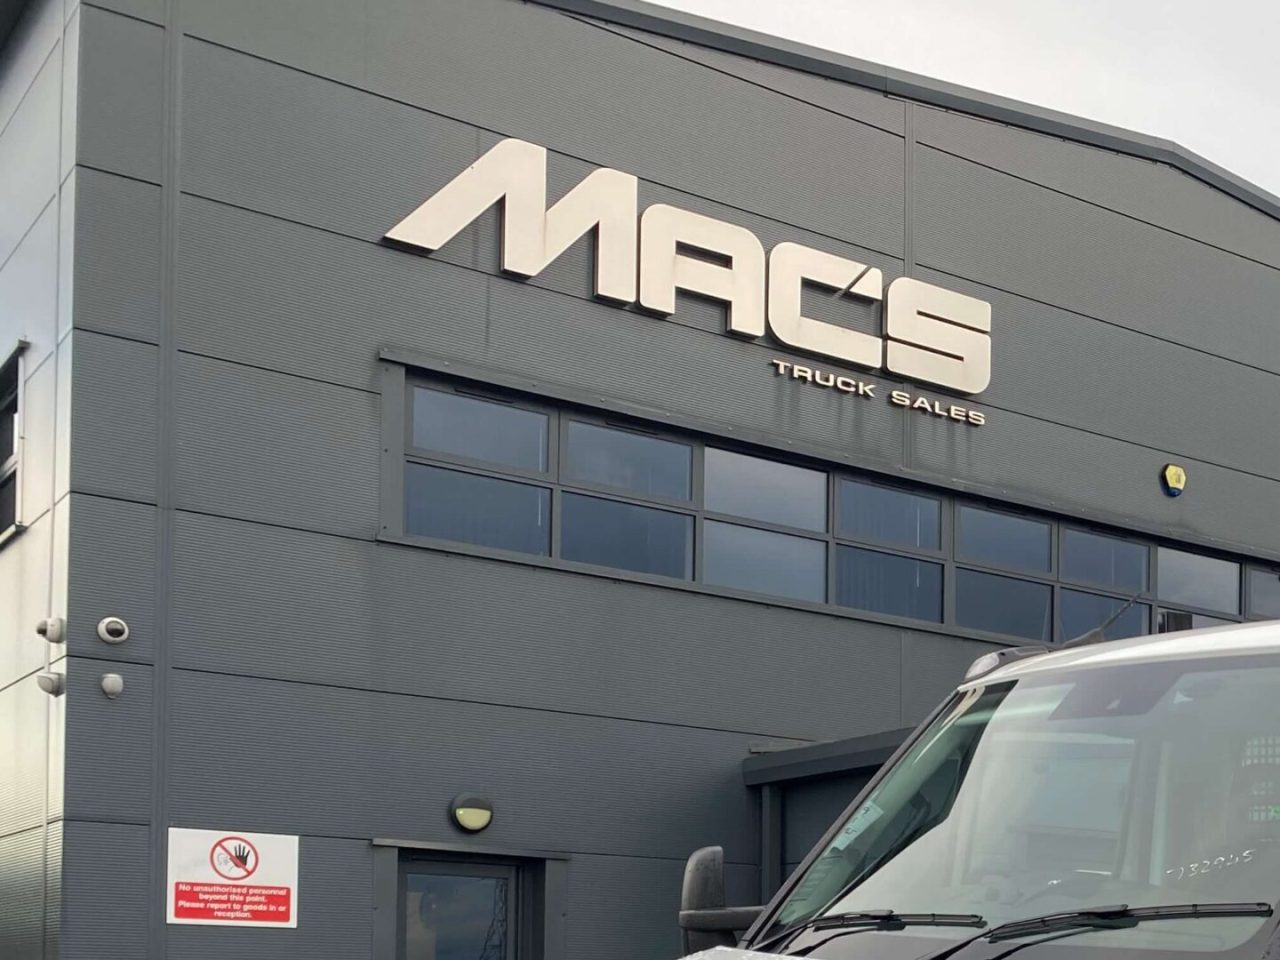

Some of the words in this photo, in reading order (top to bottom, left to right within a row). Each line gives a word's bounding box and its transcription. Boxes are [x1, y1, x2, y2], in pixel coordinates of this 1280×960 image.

[384, 138, 991, 395] MACS
[772, 359, 877, 398] TRUCK
[891, 390, 986, 425] SALES
[179, 883, 191, 891] No
[193, 885, 247, 894] unauthorised
[249, 888, 287, 896] personnel
[199, 893, 228, 901] beyond
[178, 900, 205, 908] Please
[207, 902, 231, 910] report
[243, 903, 267, 911] goods
[269, 903, 277, 911] in
